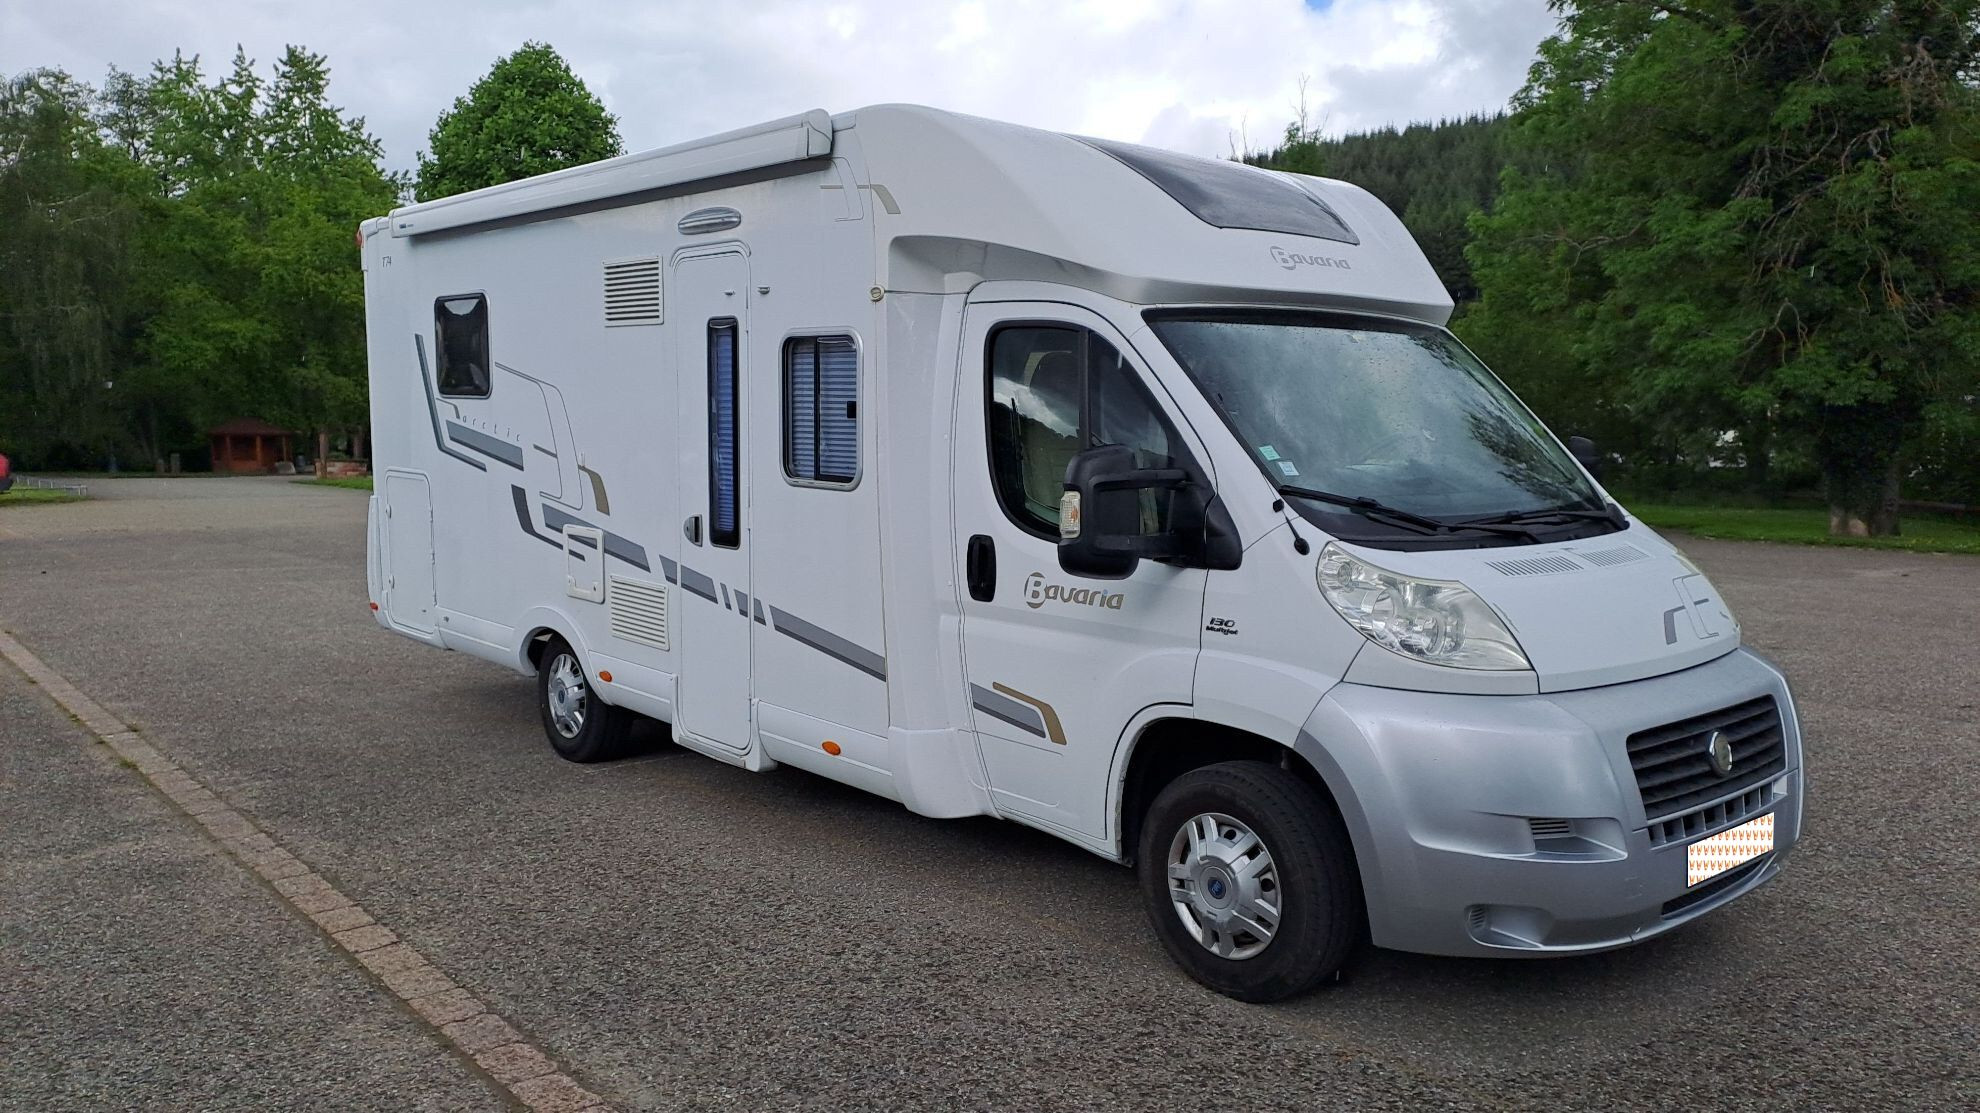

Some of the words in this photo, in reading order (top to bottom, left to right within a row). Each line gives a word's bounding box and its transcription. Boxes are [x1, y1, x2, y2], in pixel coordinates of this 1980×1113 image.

[1270, 246, 1352, 270] Bavaria
[462, 415, 521, 442] arctic
[1023, 571, 1125, 610] Bavaria
[1209, 616, 1235, 628] 130
